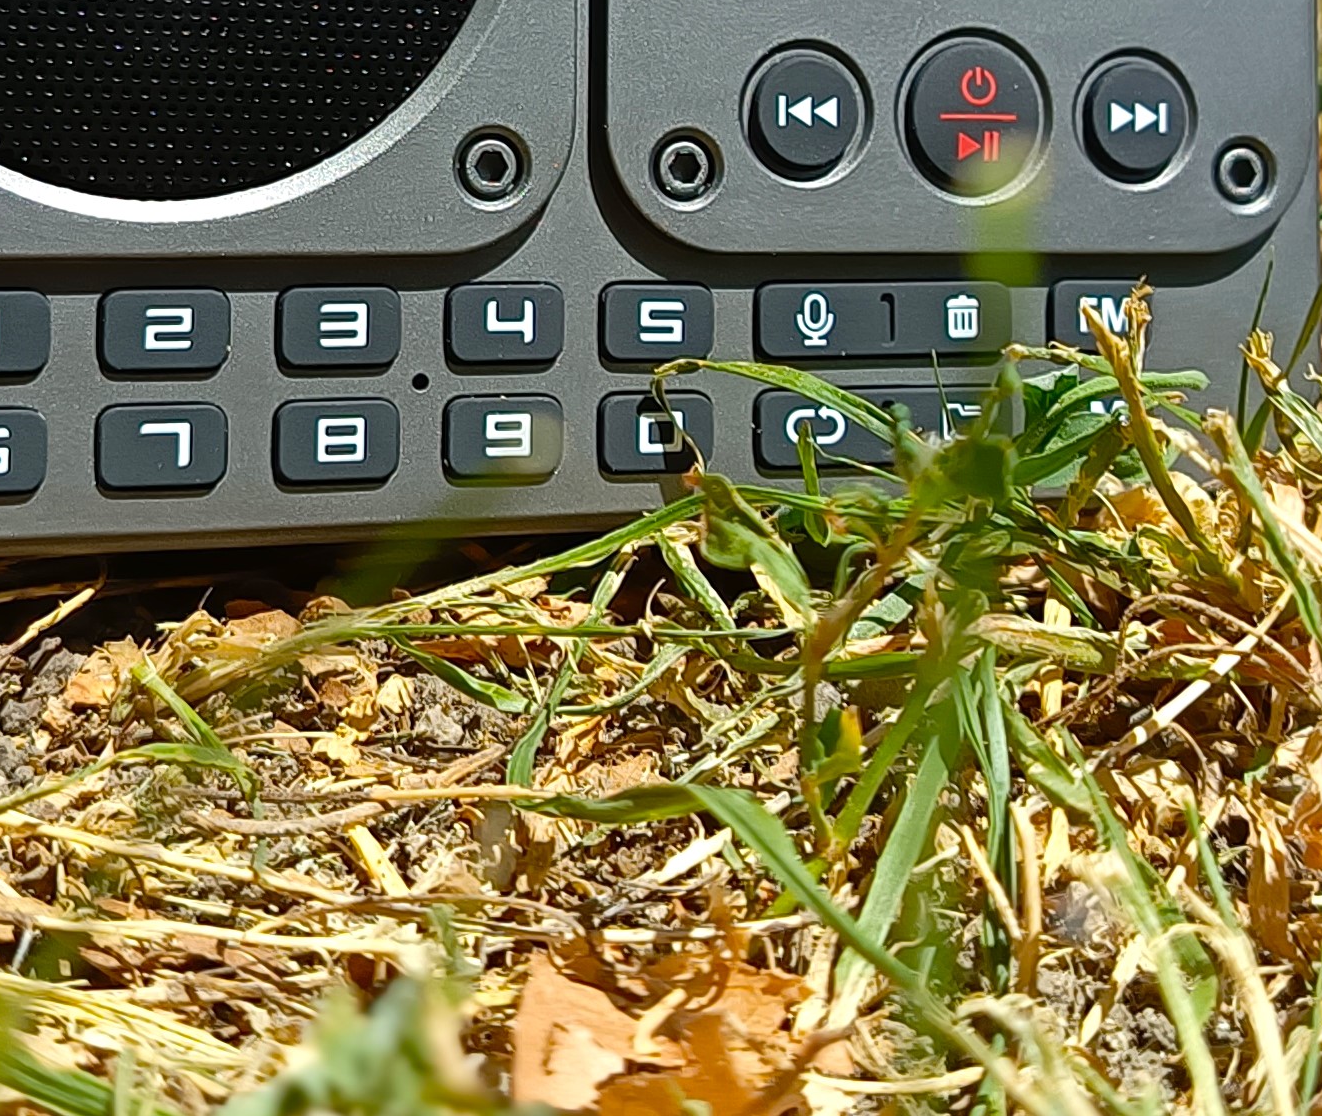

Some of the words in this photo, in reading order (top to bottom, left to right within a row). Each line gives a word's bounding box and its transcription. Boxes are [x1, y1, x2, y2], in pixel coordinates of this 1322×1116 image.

[144, 306, 194, 351] 2
[318, 302, 369, 349] 3
[485, 299, 535, 344] 4
[638, 300, 686, 344] 5
[138, 421, 192, 468] 7
[316, 416, 366, 464] 8
[484, 412, 533, 458] 9
